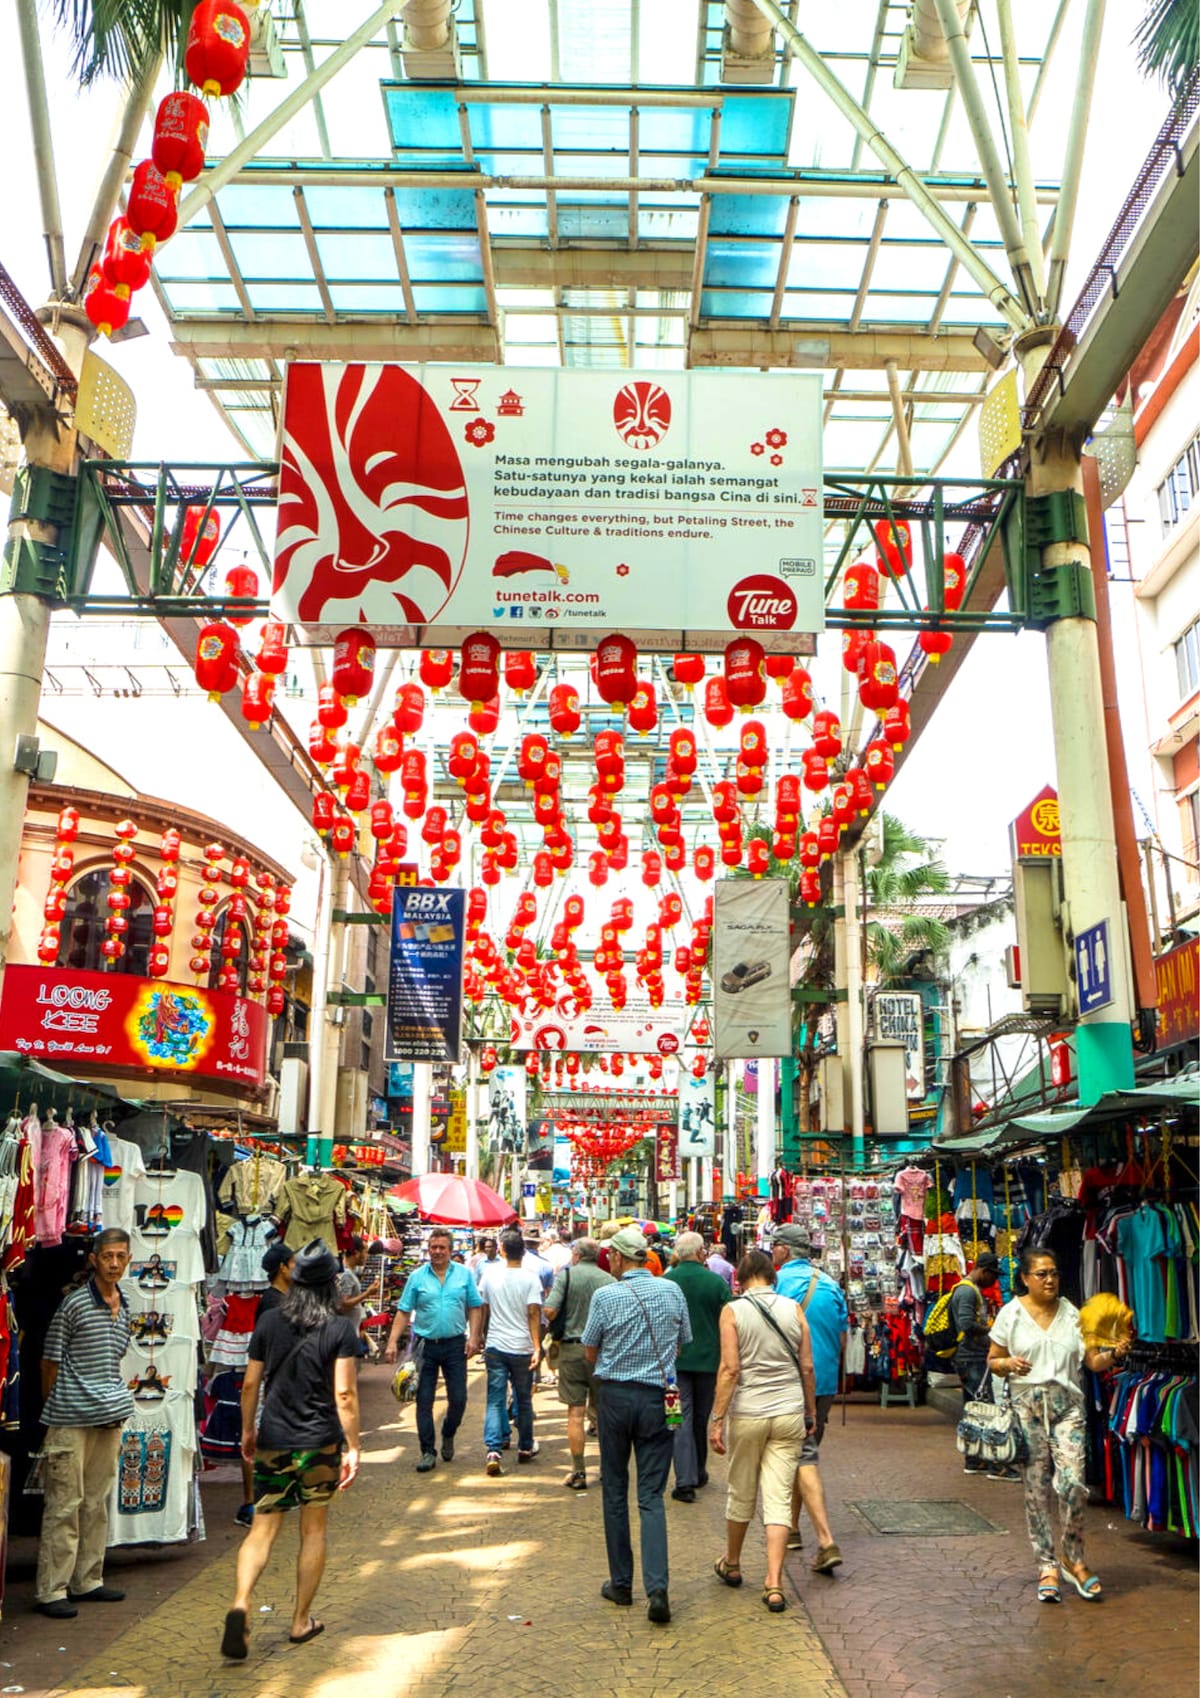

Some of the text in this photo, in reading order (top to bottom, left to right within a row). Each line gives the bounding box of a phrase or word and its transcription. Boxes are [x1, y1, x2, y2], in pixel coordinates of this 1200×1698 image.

[495, 455, 725, 472] Masa mengubah segala-galanya.
[494, 470, 778, 488] Satu-satunya yang kekal ialah semangat
[494, 486, 801, 504] kebudayaan dan tradisi bangsa Cina di sini.
[494, 512, 794, 528] Time changes everything, but Petaling Street, the
[493, 525, 713, 539] Chinese Culture & traditions endure.
[495, 590, 600, 603] tunetalk.com
[563, 609, 607, 618] /tunetalk
[734, 590, 792, 621] Tune
[750, 615, 777, 624] Talk
[1040, 804, 1060, 830] 泉
[405, 892, 453, 912] BBX
[403, 912, 452, 920] MALAYSIA
[36, 984, 112, 1010] LOONG
[879, 999, 918, 1015] HOTEL
[41, 1010, 100, 1033] KEE
[880, 1015, 918, 1032] CHINA
